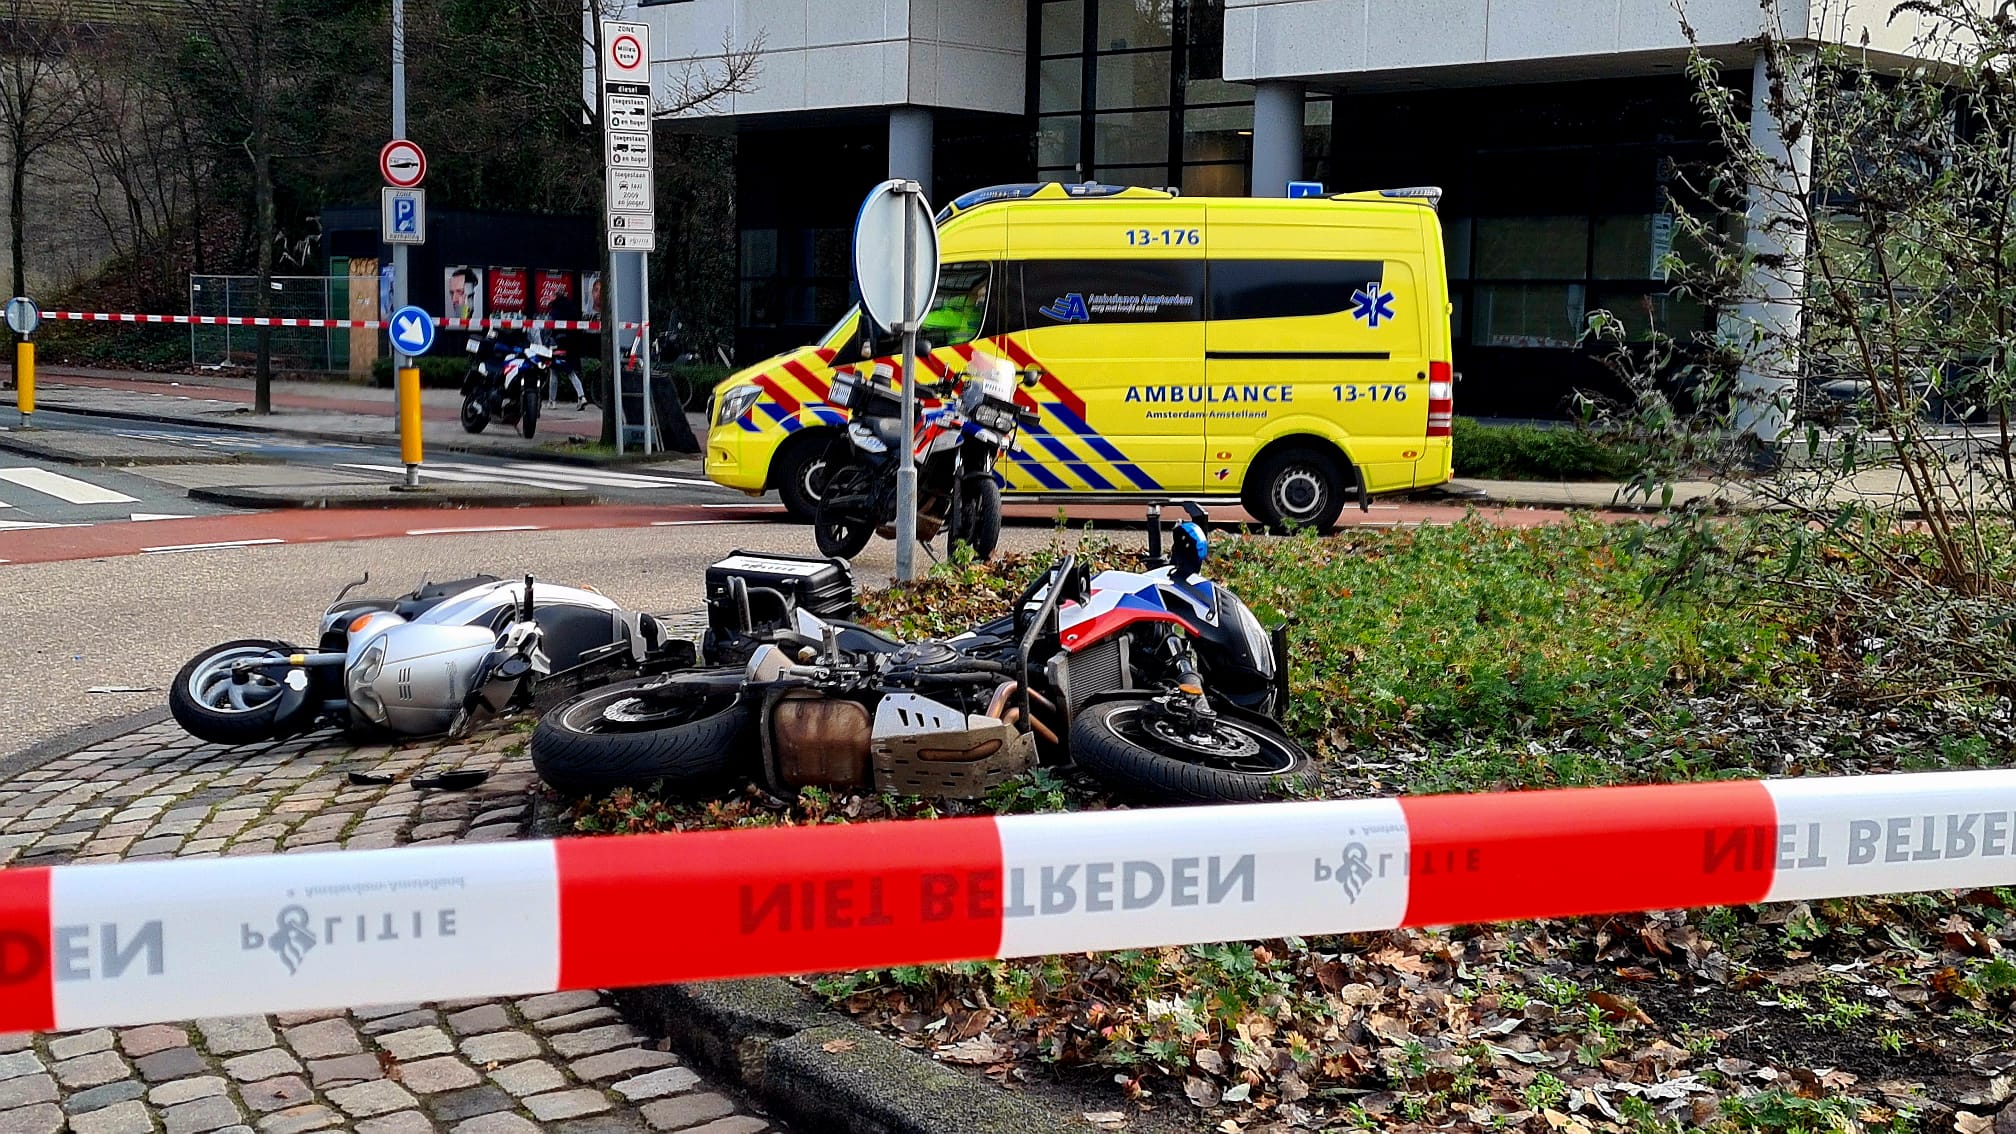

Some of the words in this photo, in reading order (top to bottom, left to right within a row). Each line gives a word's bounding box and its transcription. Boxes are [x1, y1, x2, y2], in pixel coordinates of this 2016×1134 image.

[617, 25, 635, 33] ZONE
[617, 85, 638, 93] diesel
[612, 98, 644, 106] toegestaan
[614, 171, 646, 179] toegestaan
[398, 200, 411, 219] P
[1126, 229, 1200, 246] 13-176
[1088, 293, 1140, 305] Ambulance
[1140, 293, 1193, 306] Amsterdam
[1125, 385, 1293, 403] AMBULANCE
[1332, 385, 1407, 402] 13-176
